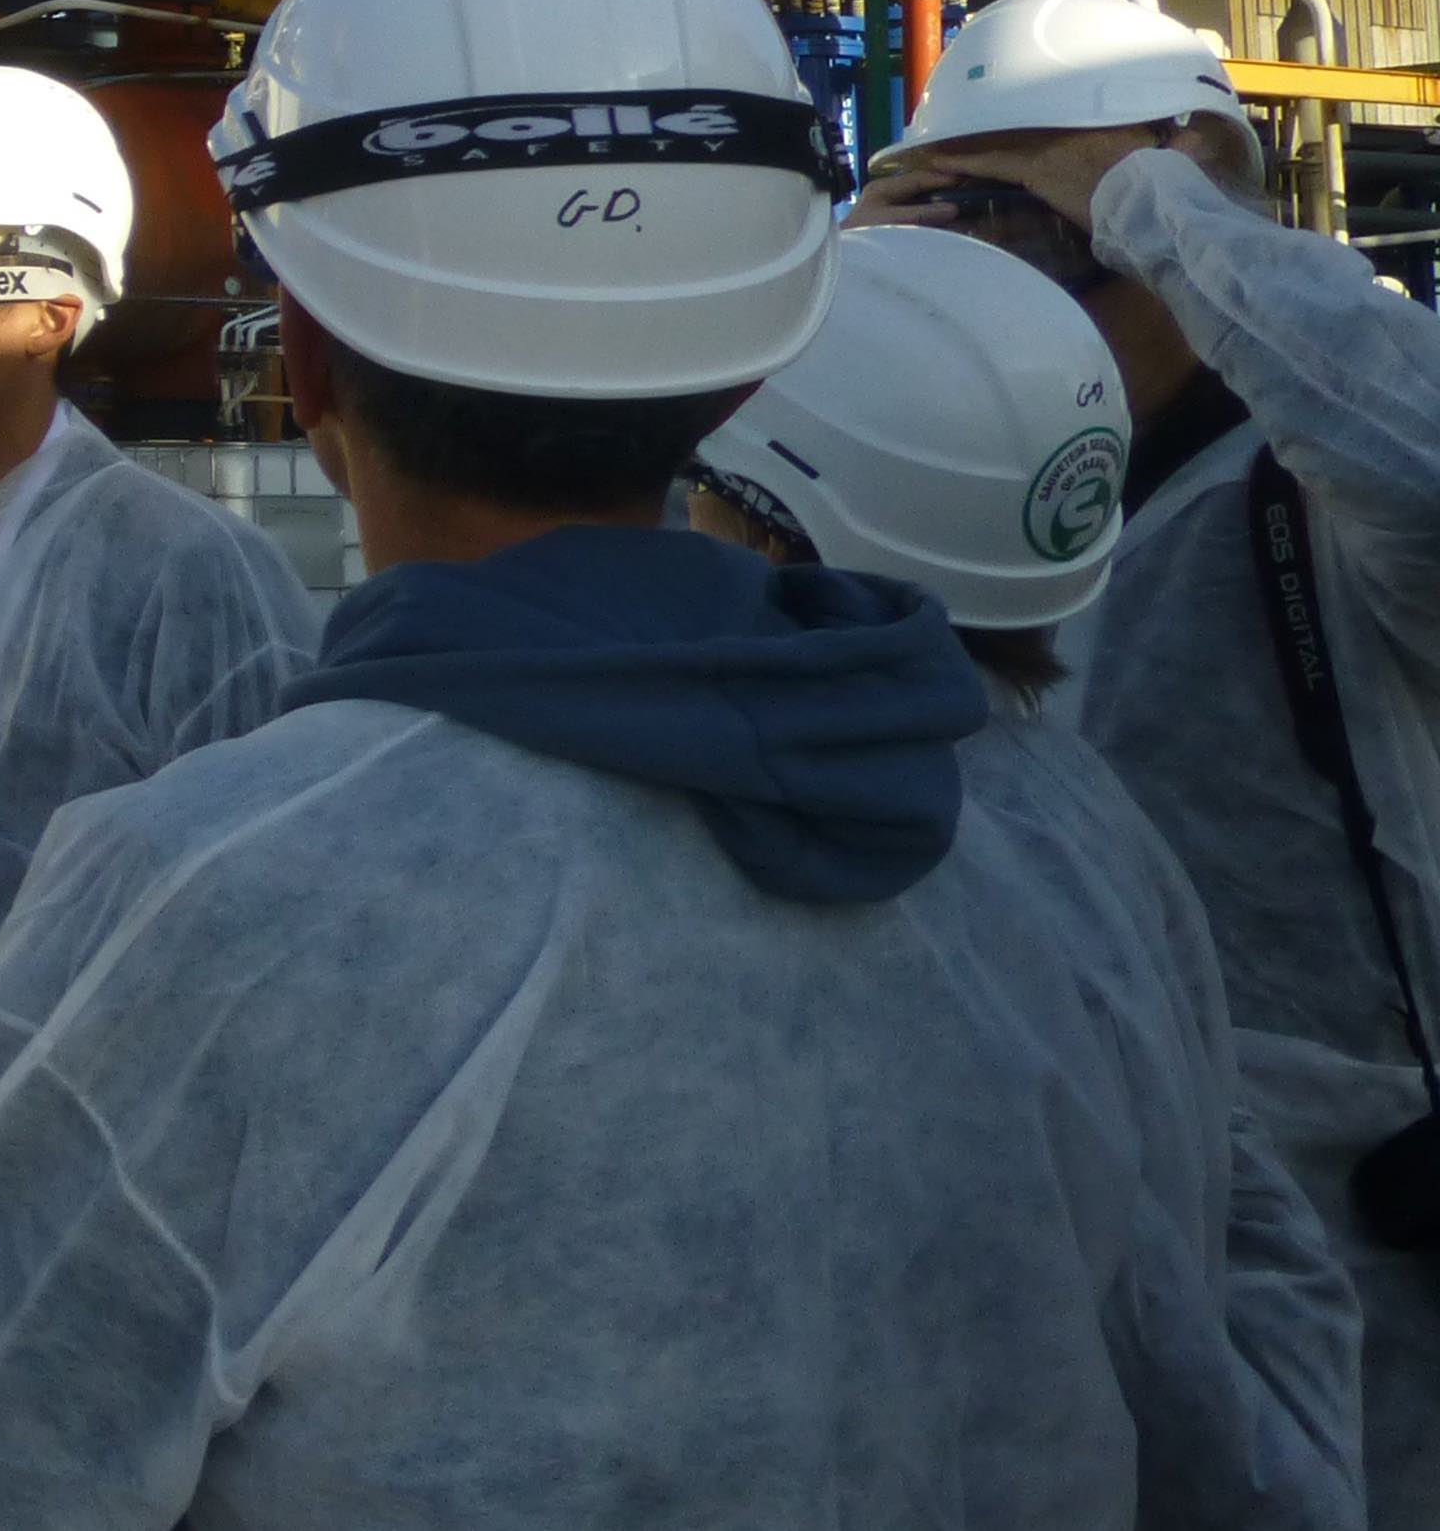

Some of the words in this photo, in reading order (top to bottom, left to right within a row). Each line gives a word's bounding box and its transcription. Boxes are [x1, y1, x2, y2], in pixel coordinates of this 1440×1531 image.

[402, 138, 726, 167] SAFETY
[1266, 503, 1295, 563] EOS
[1279, 573, 1325, 691] DIGITAL
